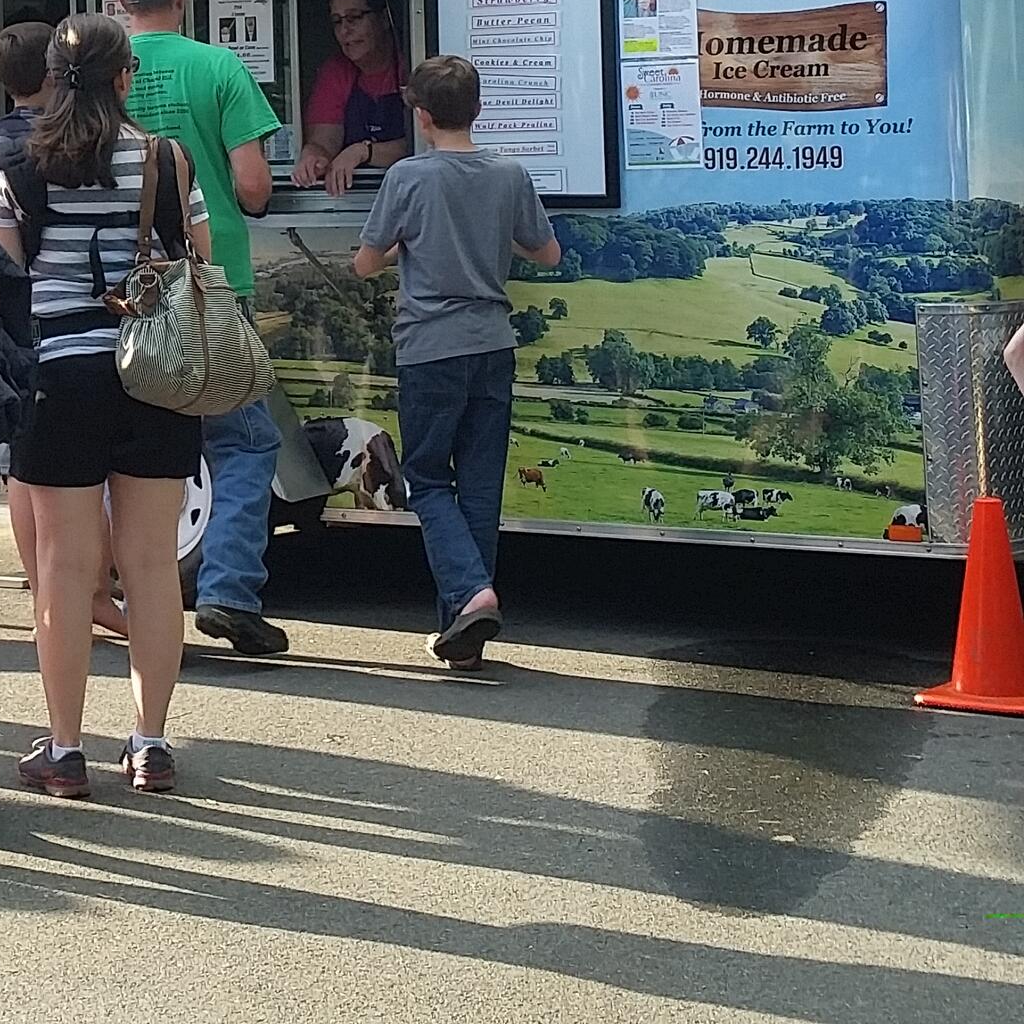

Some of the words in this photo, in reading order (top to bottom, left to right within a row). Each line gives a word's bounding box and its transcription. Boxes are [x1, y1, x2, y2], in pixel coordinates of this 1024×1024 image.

[477, 18, 512, 27] Butter
[517, 17, 550, 25] Pecan
[712, 62, 747, 80] Ice
[753, 59, 829, 80] Cream
[700, 89, 751, 102] Hormone
[752, 91, 763, 102] &
[763, 90, 819, 104] Antibiotic
[820, 92, 847, 103] Free
[748, 121, 777, 137] the
[782, 120, 835, 137] Farm
[840, 121, 860, 135] to
[866, 118, 913, 135] You!
[704, 145, 843, 170] 919.244.1949
